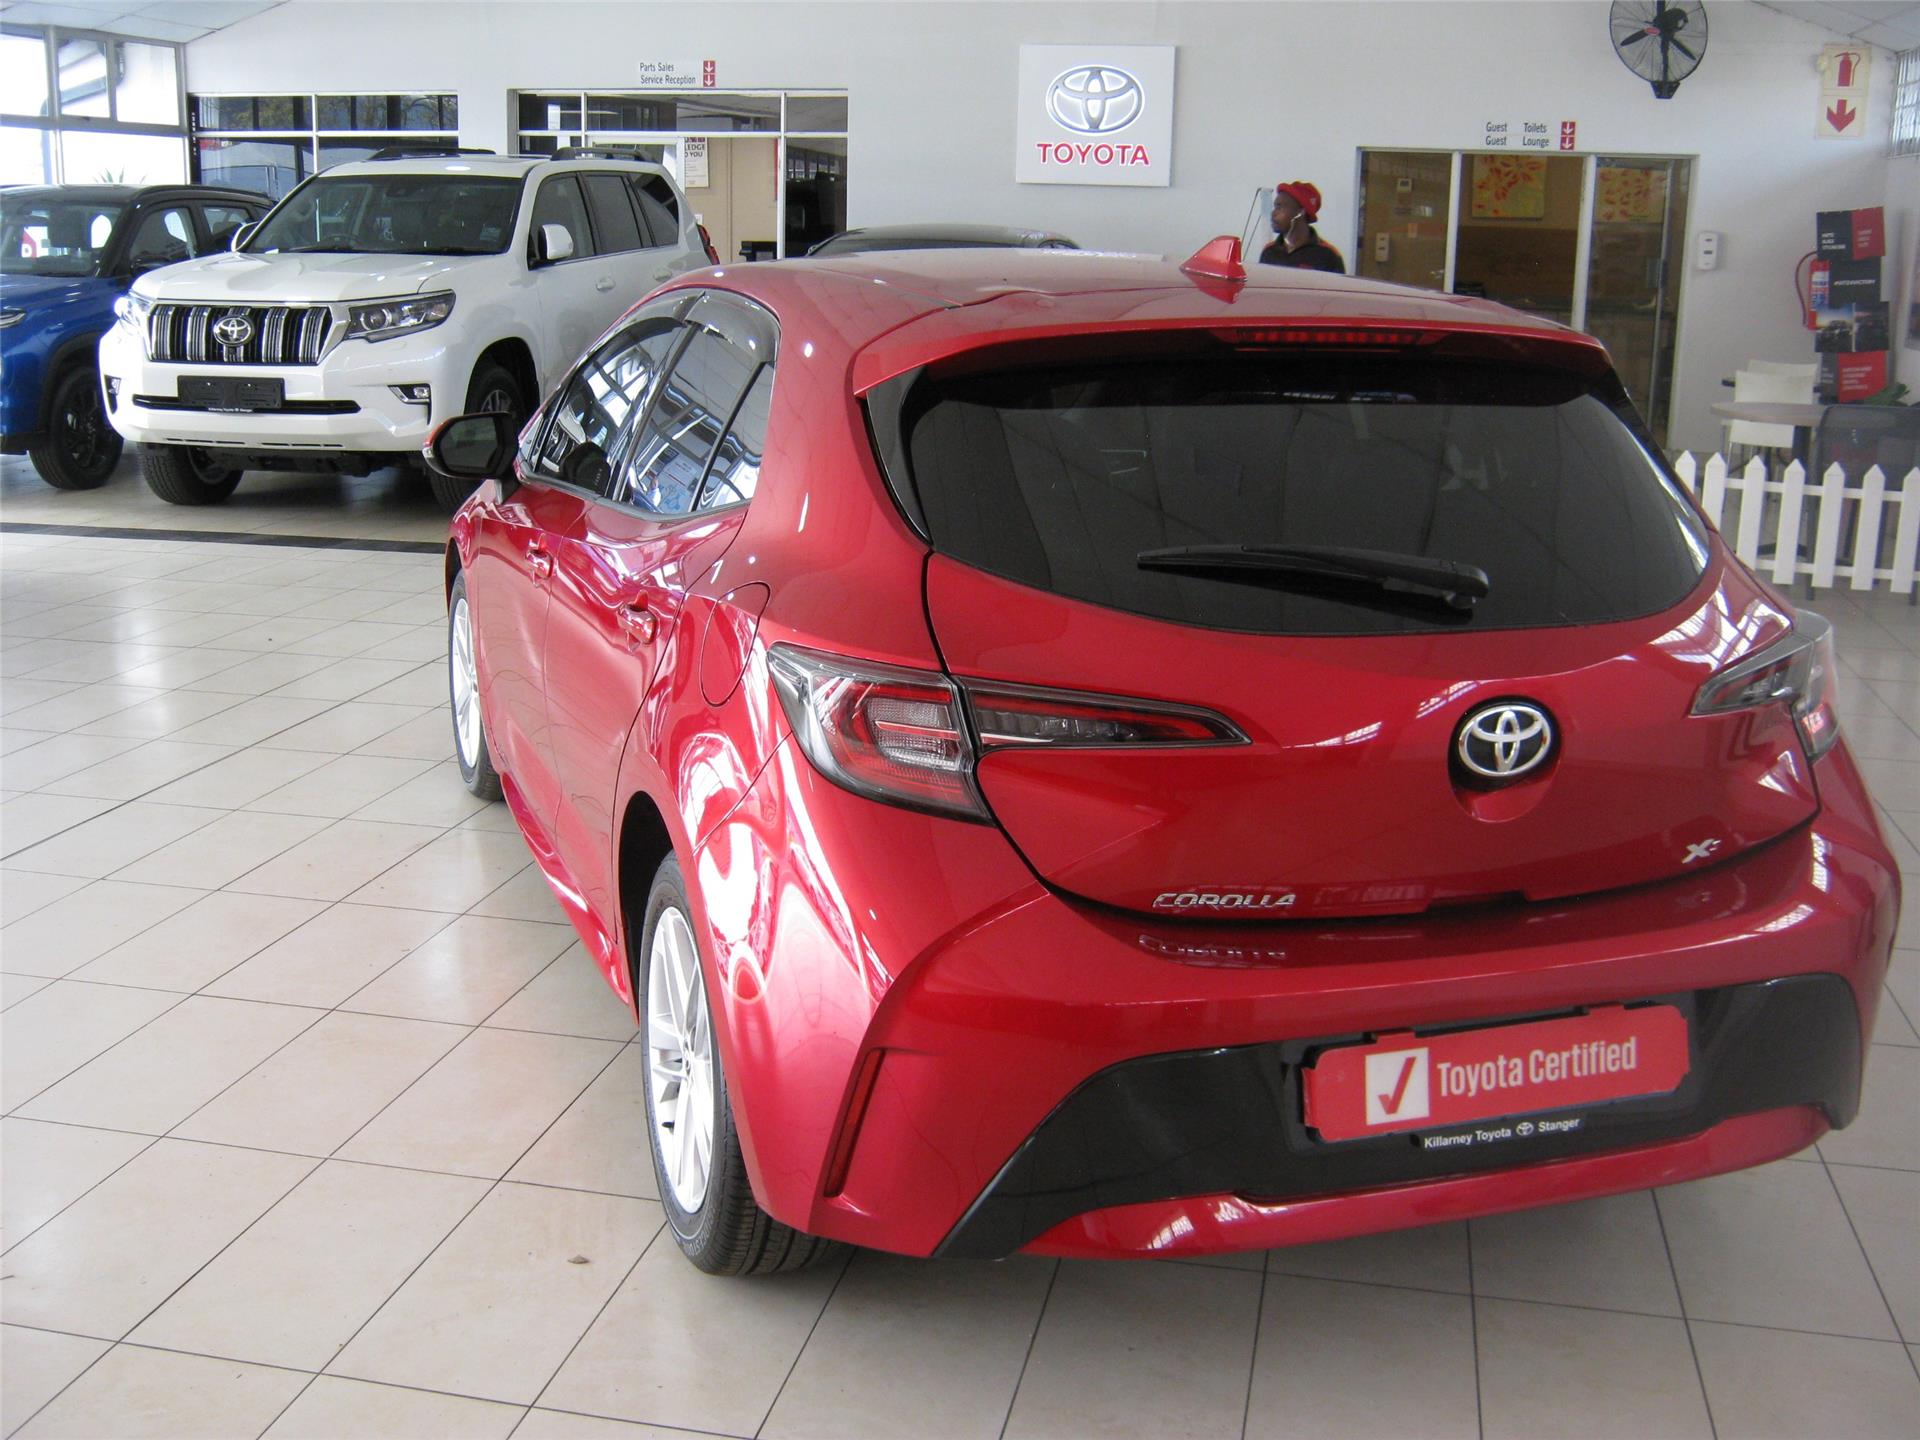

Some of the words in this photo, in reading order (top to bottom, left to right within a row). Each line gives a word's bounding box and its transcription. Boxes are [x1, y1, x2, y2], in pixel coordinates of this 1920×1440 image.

[640, 62, 656, 72] Parts
[658, 62, 674, 72] Sales
[640, 75, 663, 84] Service
[665, 75, 696, 86] Reception
[1486, 122, 1508, 132] Guest
[1523, 122, 1547, 133] Toilets
[1485, 135, 1507, 146] Guest
[1522, 136, 1550, 148] Lounge
[1036, 143, 1150, 165] TOYOTA
[1152, 893, 1297, 911] COROLLA
[1436, 1055, 1524, 1098] Toyota
[1528, 1036, 1638, 1084] Certified
[1424, 1132, 1473, 1149] Killarney
[1475, 1127, 1512, 1142] Toyota
[1538, 1117, 1581, 1133] Stanger
